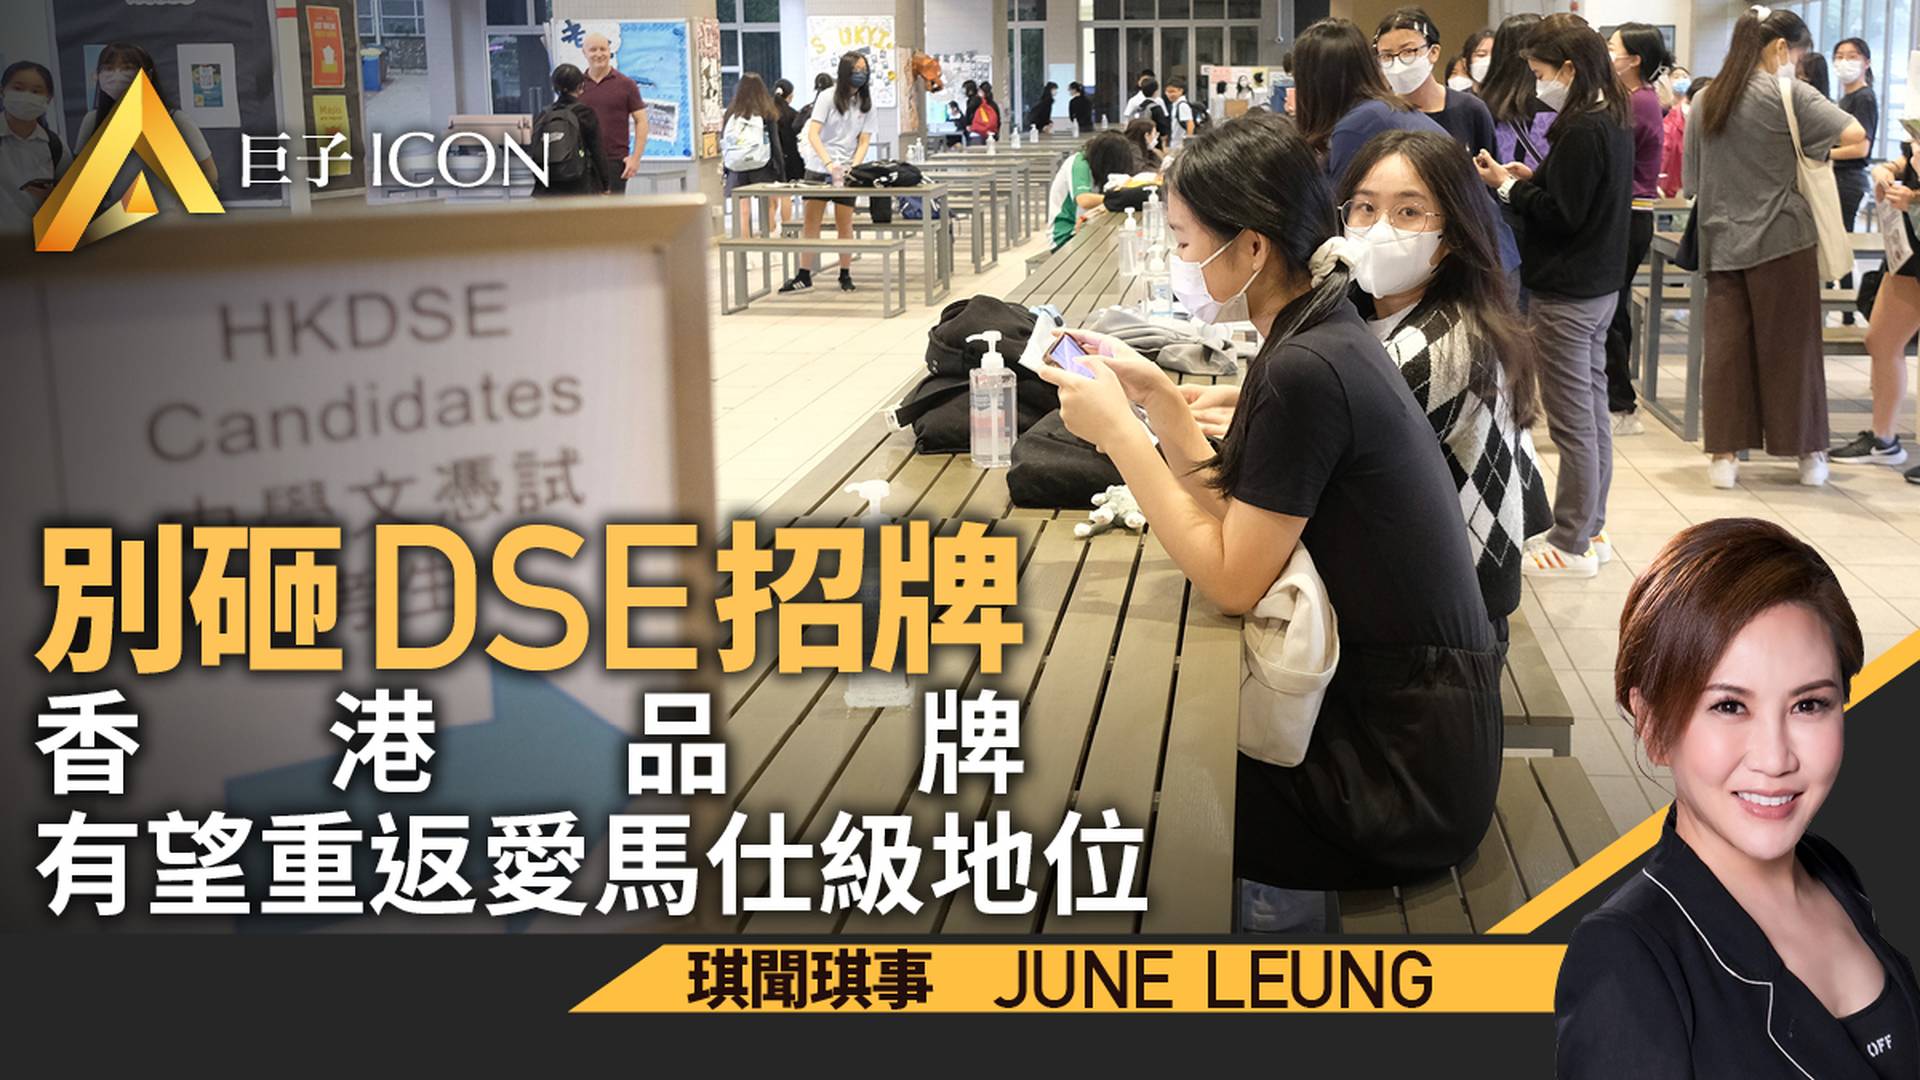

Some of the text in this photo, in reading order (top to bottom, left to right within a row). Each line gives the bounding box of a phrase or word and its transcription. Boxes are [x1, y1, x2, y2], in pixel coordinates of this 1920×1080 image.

[217, 281, 511, 363] HKDSE
[146, 374, 584, 464] Candidates
[1866, 1033, 1893, 1058] OFF
